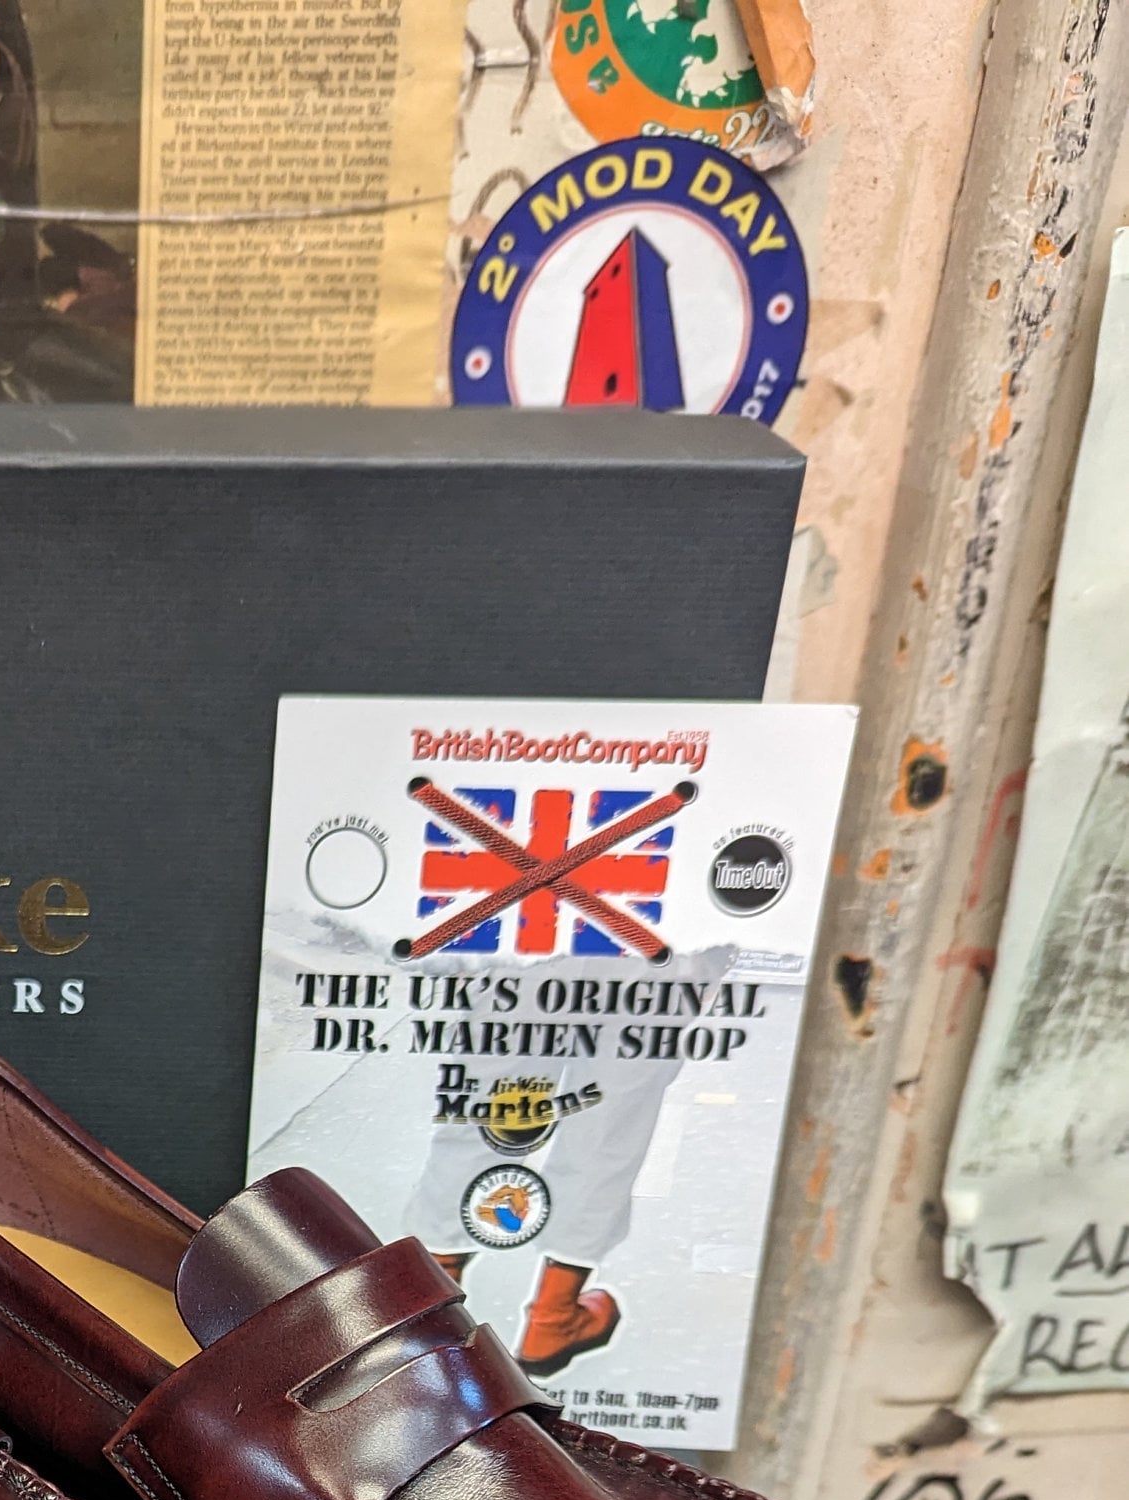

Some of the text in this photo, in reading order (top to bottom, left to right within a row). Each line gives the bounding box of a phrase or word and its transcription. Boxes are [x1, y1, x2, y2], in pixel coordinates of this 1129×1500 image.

[529, 149, 673, 233] MOD
[688, 159, 787, 257] DAY
[296, 972, 767, 1019] THE UK'S ORIGINAL
[312, 1017, 747, 1062] DR. MARTEN SHOP
[432, 1081, 603, 1125] Martens
[573, 1389, 590, 1405] to
